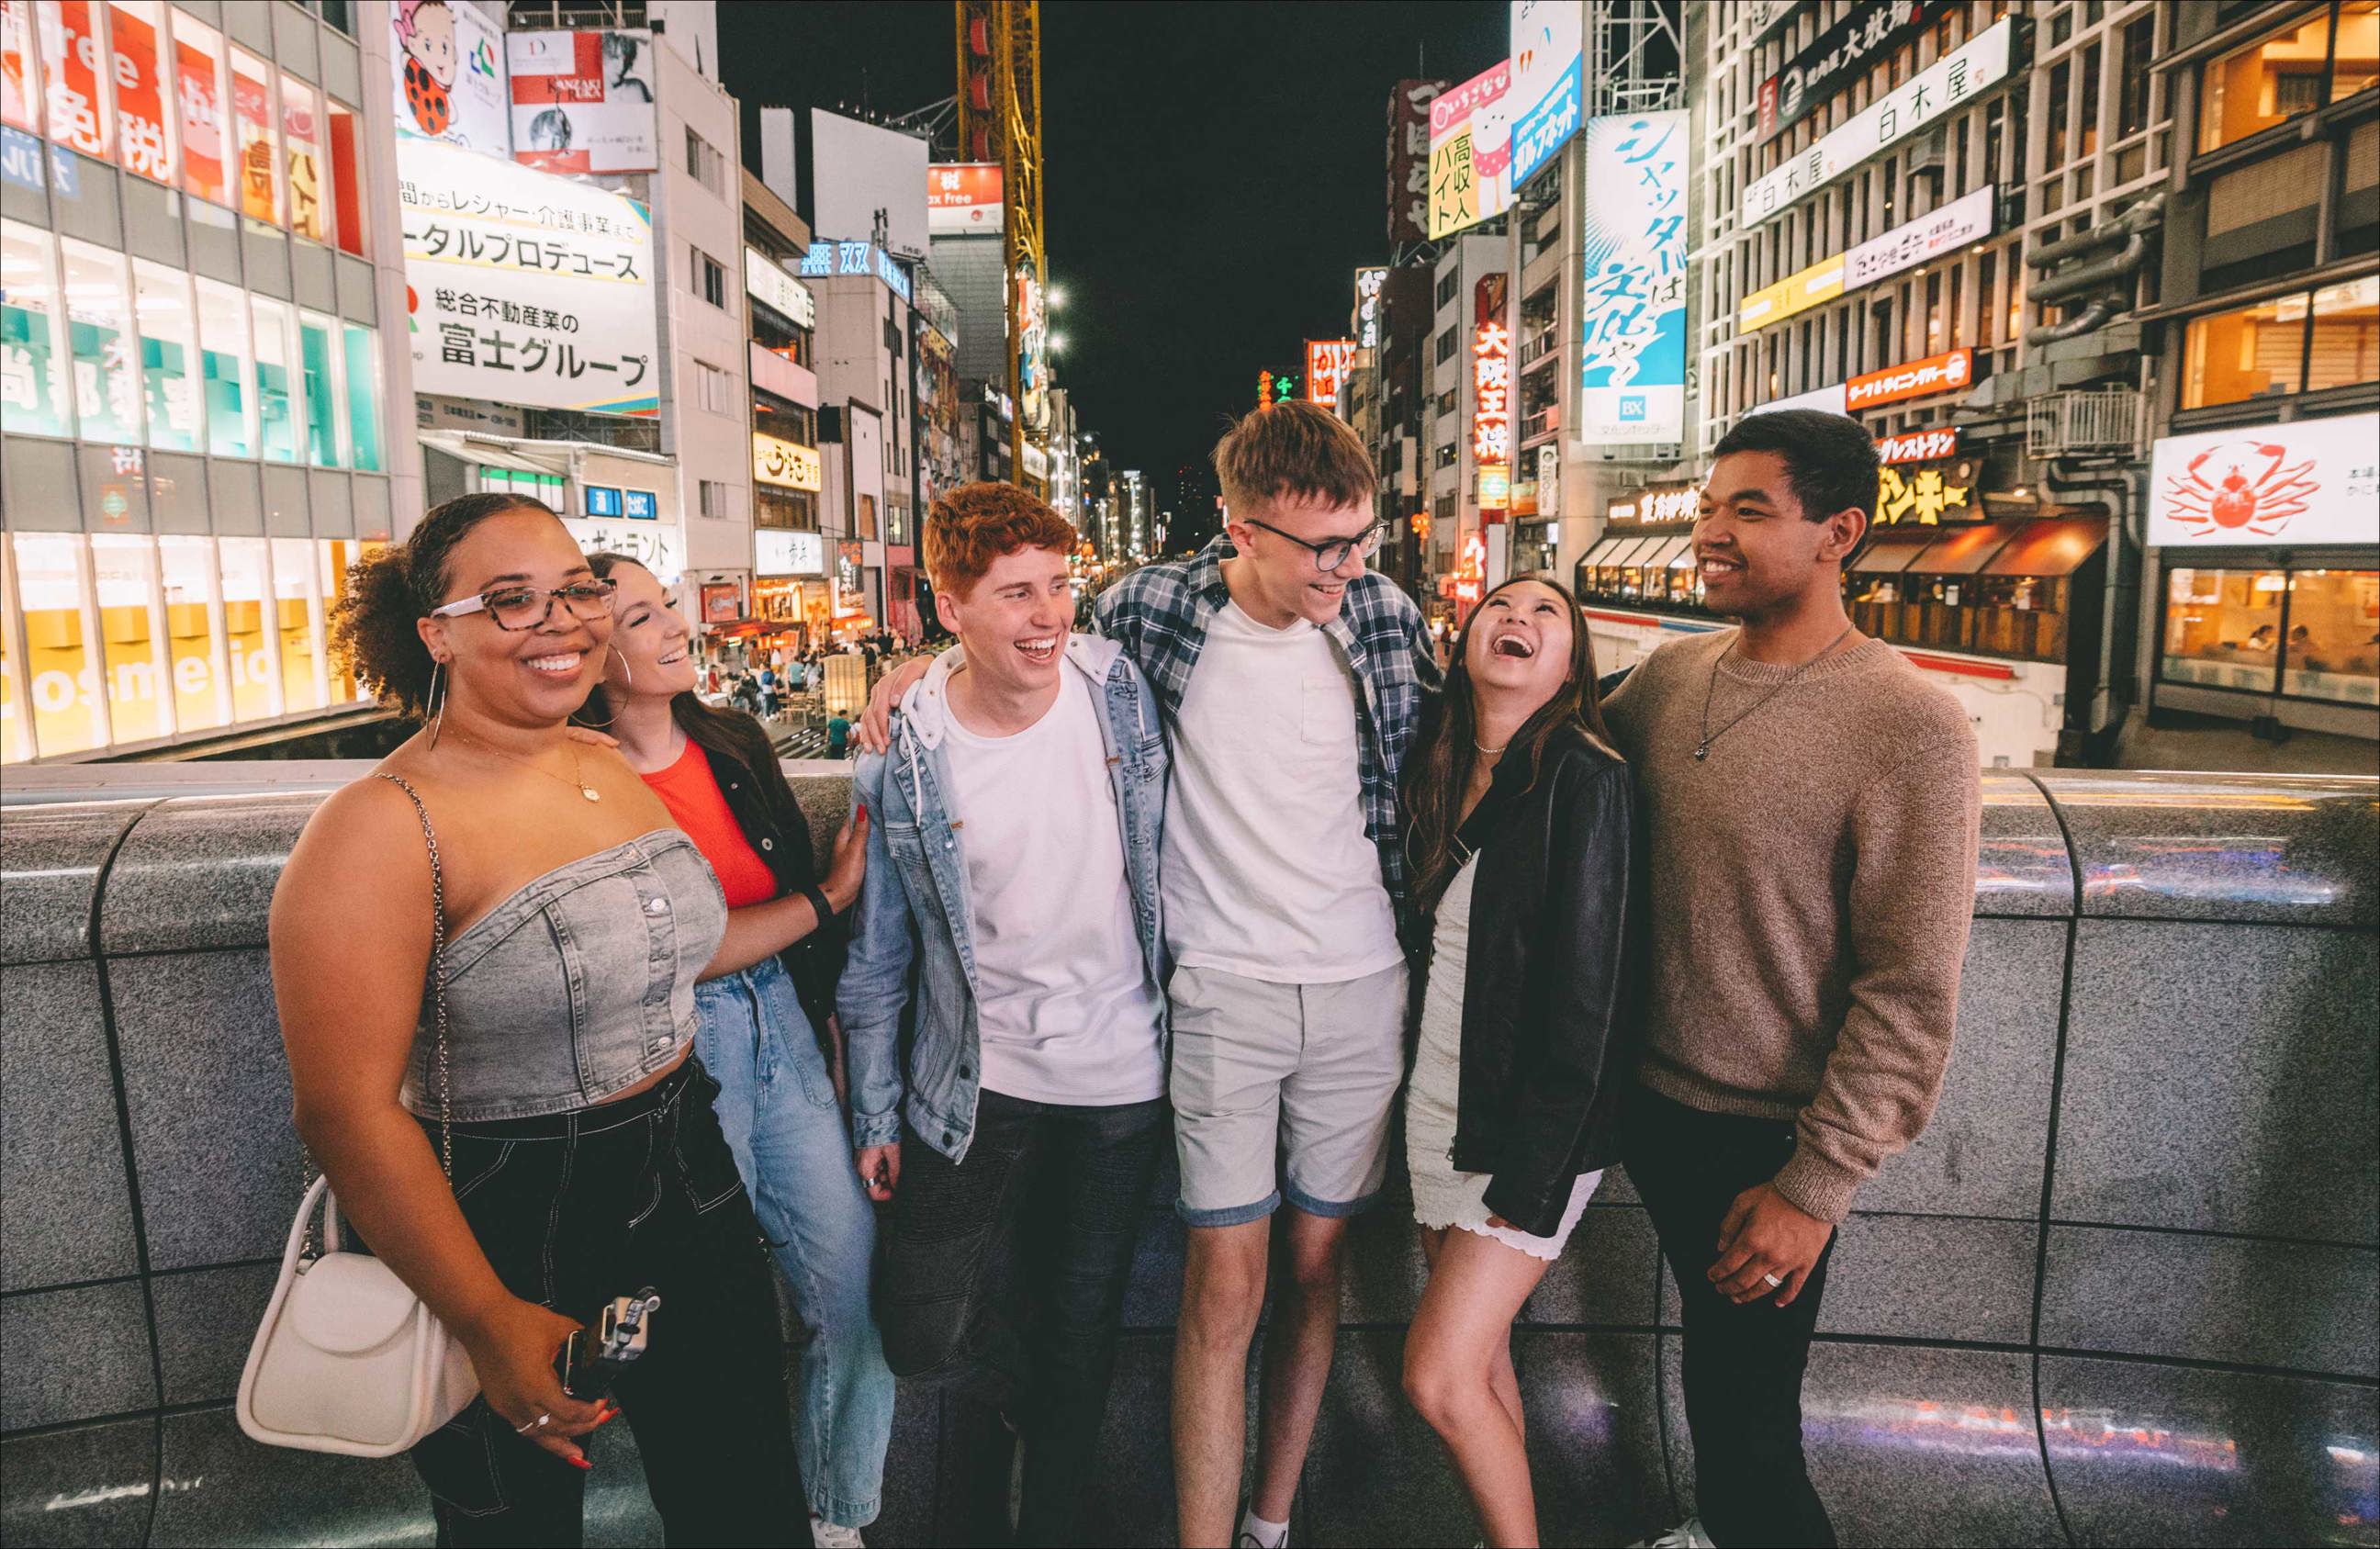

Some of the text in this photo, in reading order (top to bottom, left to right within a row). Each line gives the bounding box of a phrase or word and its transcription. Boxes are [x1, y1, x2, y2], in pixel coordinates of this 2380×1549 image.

[62, 27, 139, 88] ree
[47, 83, 169, 182] 免税
[1880, 58, 1970, 142] 白木屋
[926, 195, 942, 206] ax
[1434, 139, 1453, 232] バイト
[1453, 132, 1471, 226] 高収入
[1763, 150, 1824, 213] 白木屋
[434, 286, 579, 334] 総合不動産業の
[439, 322, 648, 387] 富士グループ
[1474, 322, 1510, 459] 大阪王将
[1622, 400, 1644, 416] BX
[0, 639, 274, 719] osmeic
